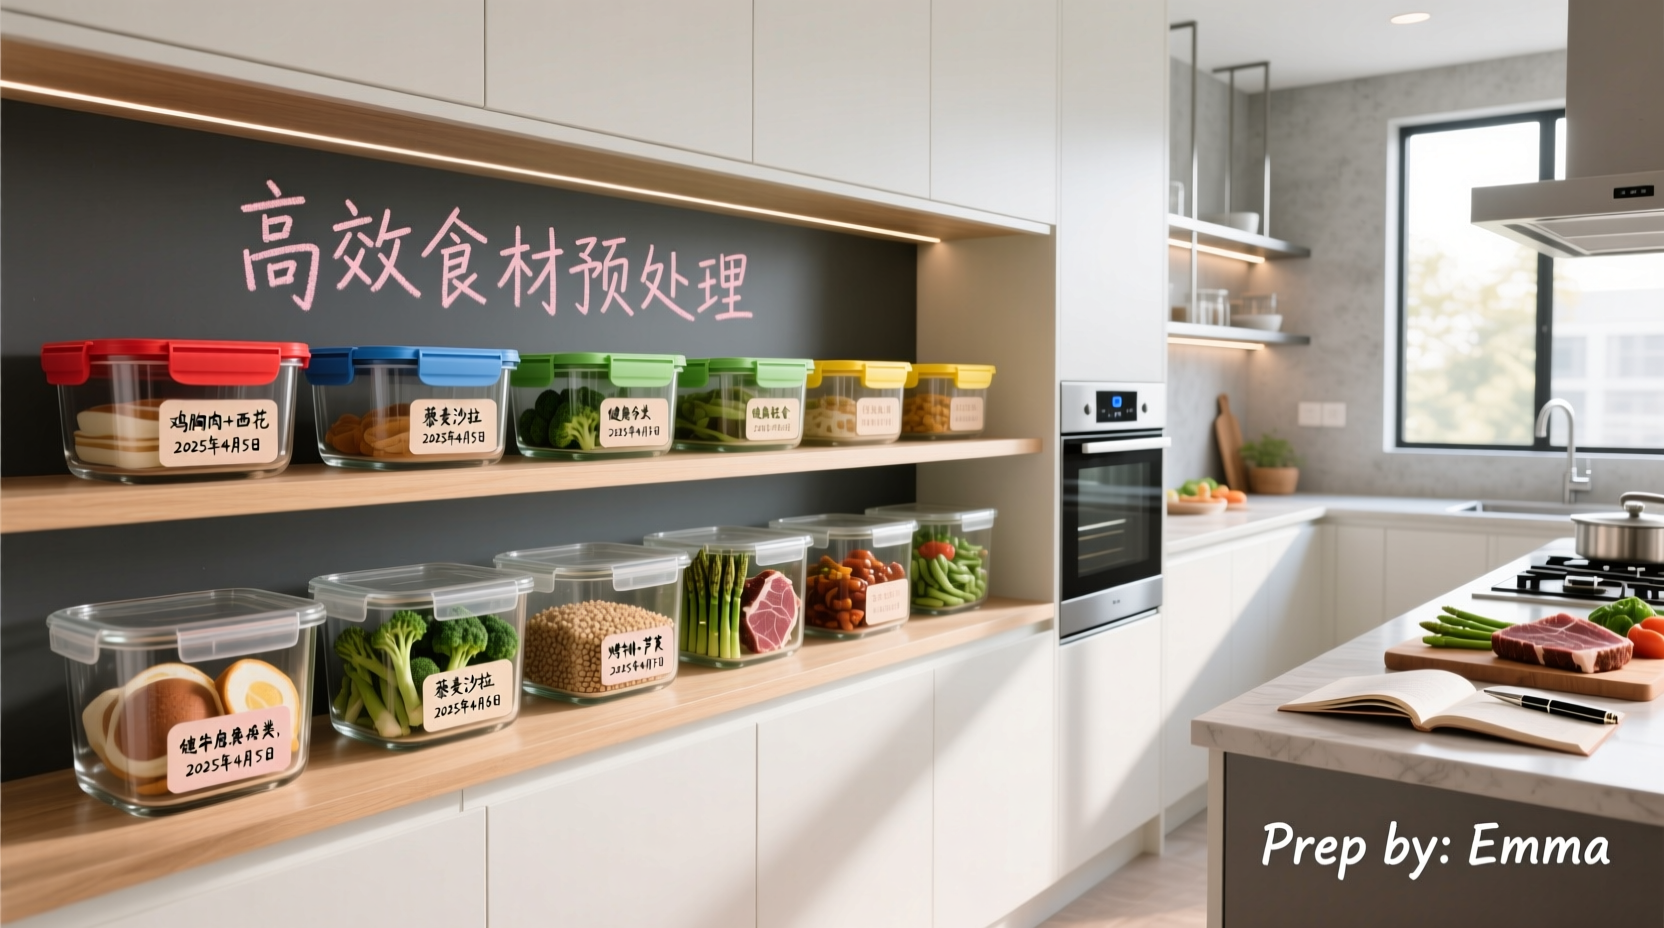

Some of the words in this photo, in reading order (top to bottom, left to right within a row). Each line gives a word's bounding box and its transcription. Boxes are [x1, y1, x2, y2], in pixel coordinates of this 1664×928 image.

[240, 179, 753, 322] 高效食材预处理
[169, 408, 269, 433] 鸡胸肉+西花
[422, 405, 482, 428] 藜麦沙拉
[173, 435, 260, 456] 2025年4月5日
[422, 430, 485, 446] 2025年4月5日
[434, 671, 495, 699] 藜麦沙拉
[434, 694, 501, 719] 2025年4月6日
[185, 746, 274, 777] 2025年4月5日
